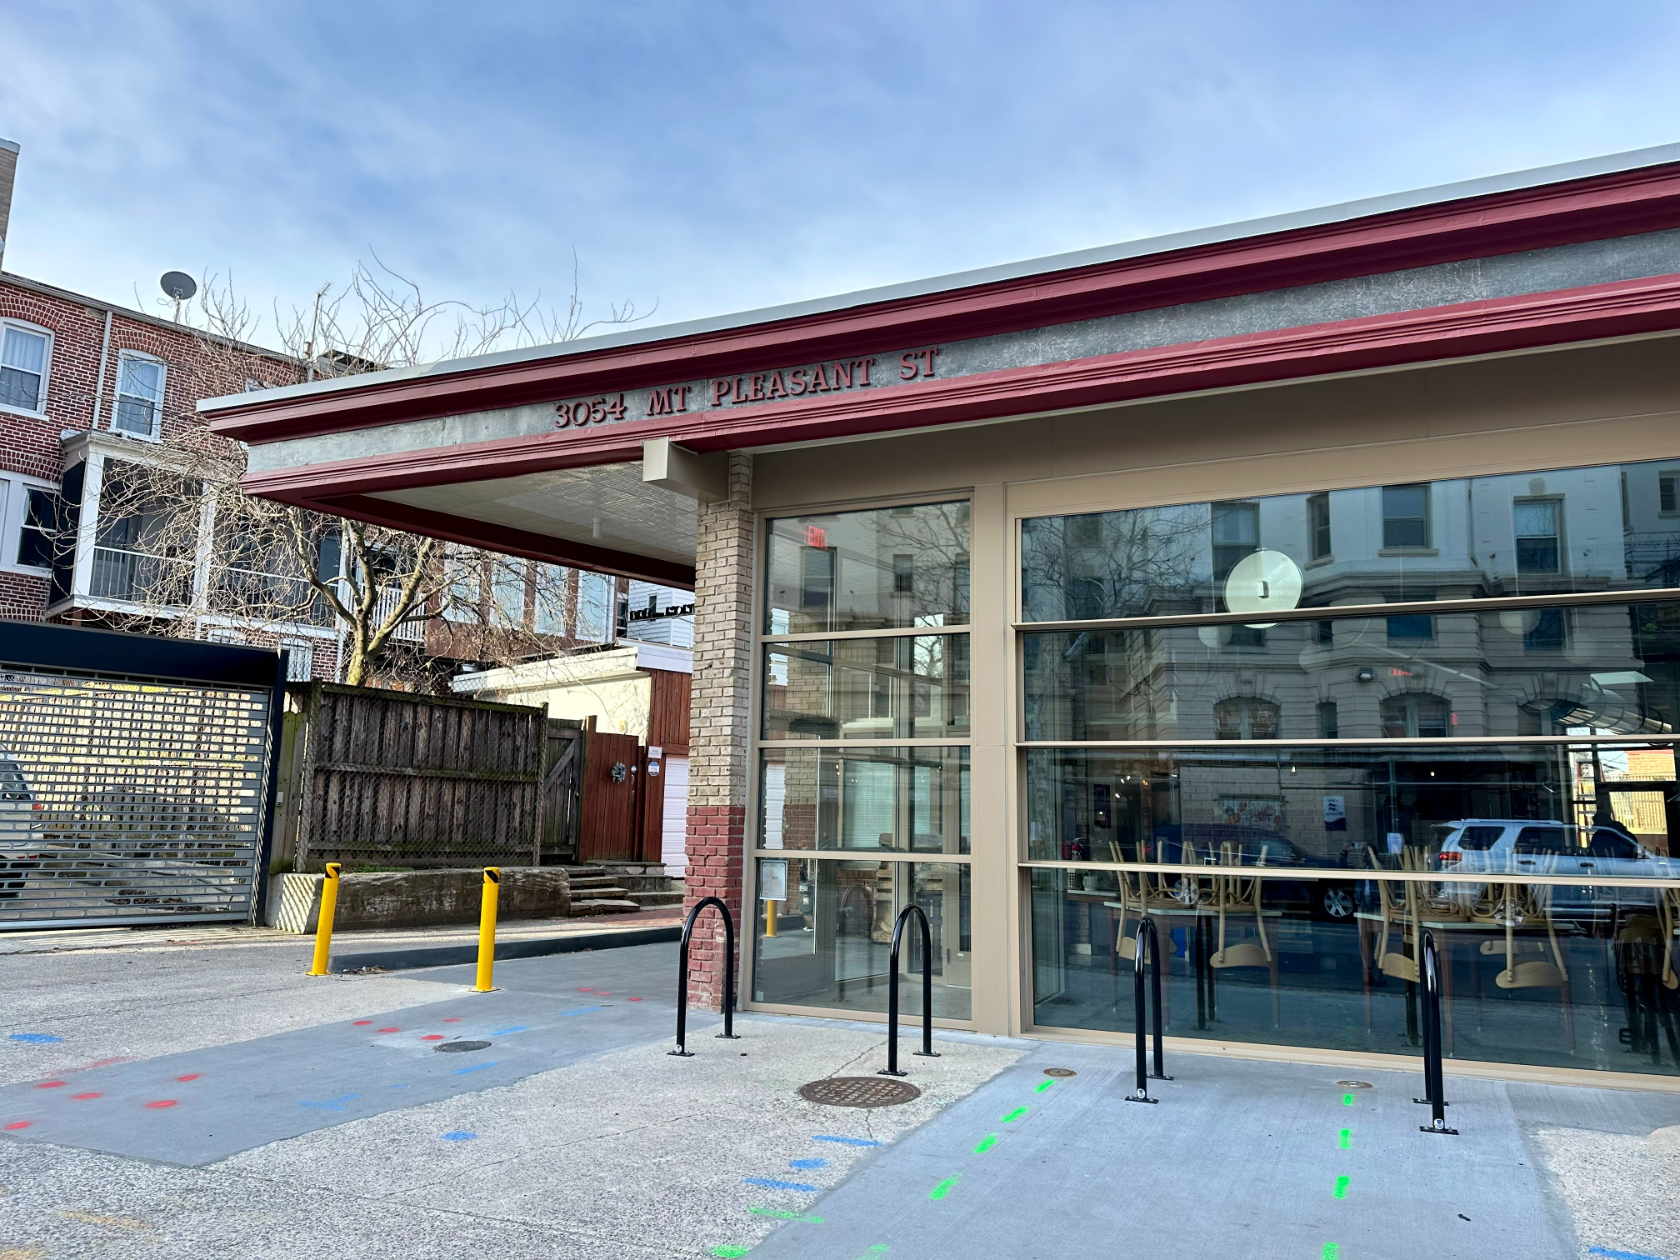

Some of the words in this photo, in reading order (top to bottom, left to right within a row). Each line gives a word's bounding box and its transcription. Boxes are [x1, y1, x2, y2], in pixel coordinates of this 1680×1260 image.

[554, 393, 627, 428] 3054
[646, 385, 690, 415] MT
[711, 357, 875, 407] PLEASANT
[899, 347, 939, 380] ST
[807, 525, 825, 549] EXIT
